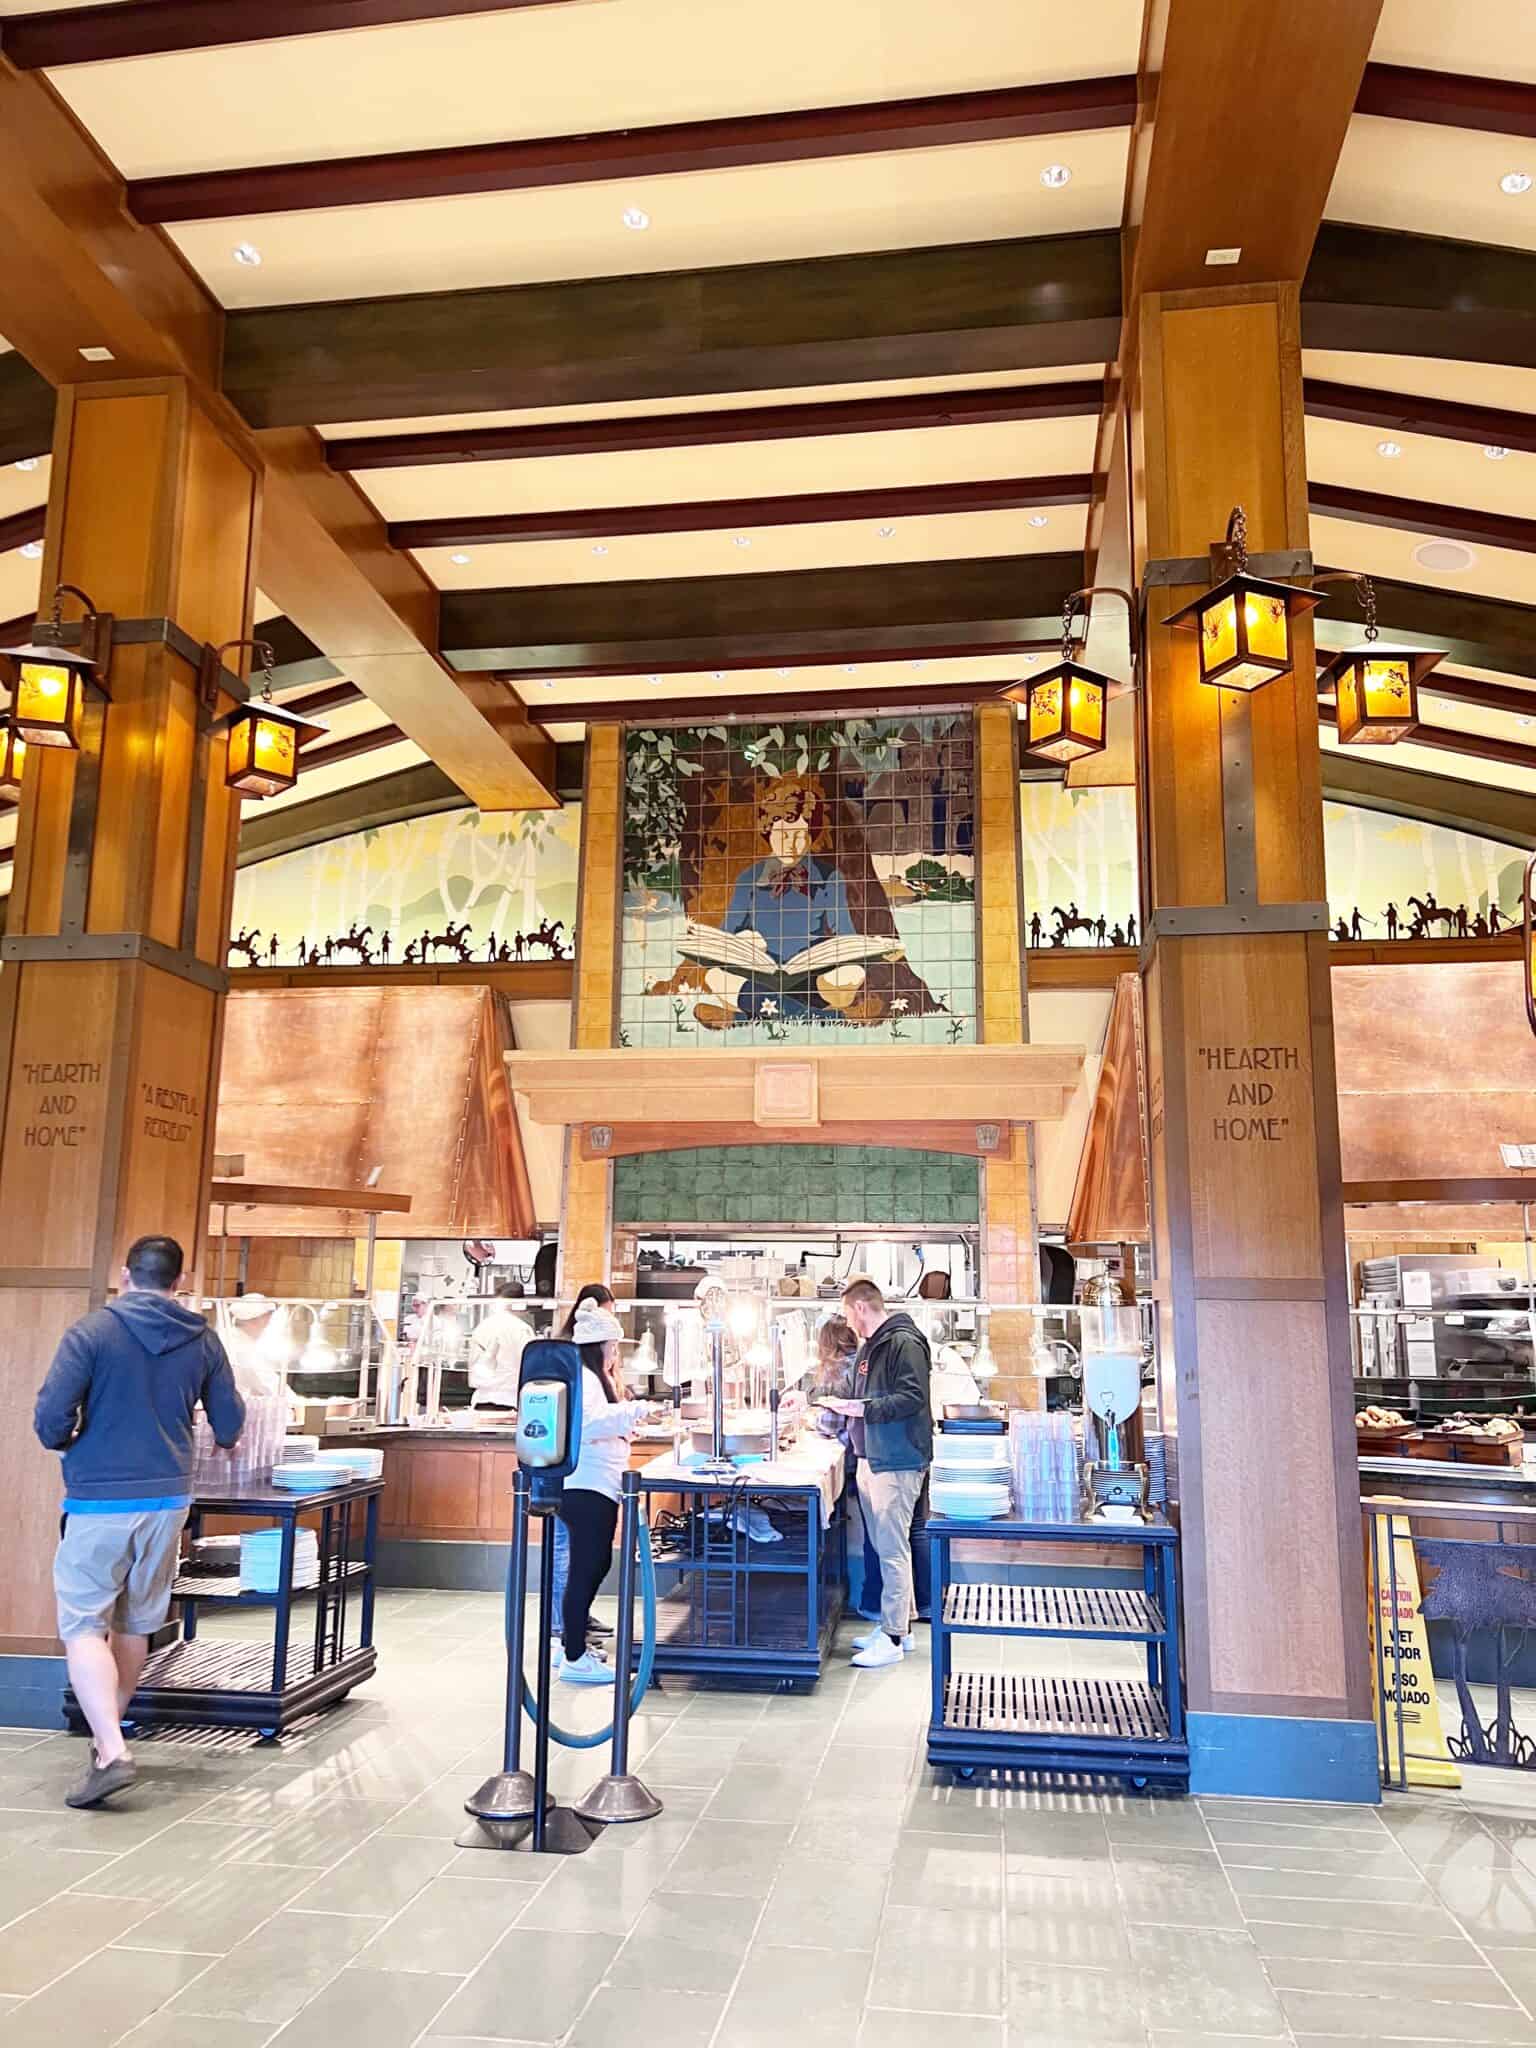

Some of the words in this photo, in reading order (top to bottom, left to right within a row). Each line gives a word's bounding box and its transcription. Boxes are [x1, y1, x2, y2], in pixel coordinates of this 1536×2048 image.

[1199, 1047, 1299, 1070] "HEARTH
[23, 1063, 102, 1084] "HEARTH
[39, 1096, 78, 1114] AND
[1227, 1083, 1274, 1106] AND
[24, 1126, 87, 1147] HOME"
[1213, 1117, 1289, 1141] HOME"
[1381, 1590, 1412, 1601] CATION
[1381, 1607, 1414, 1618] CUADO
[1392, 1673, 1418, 1687] PSO
